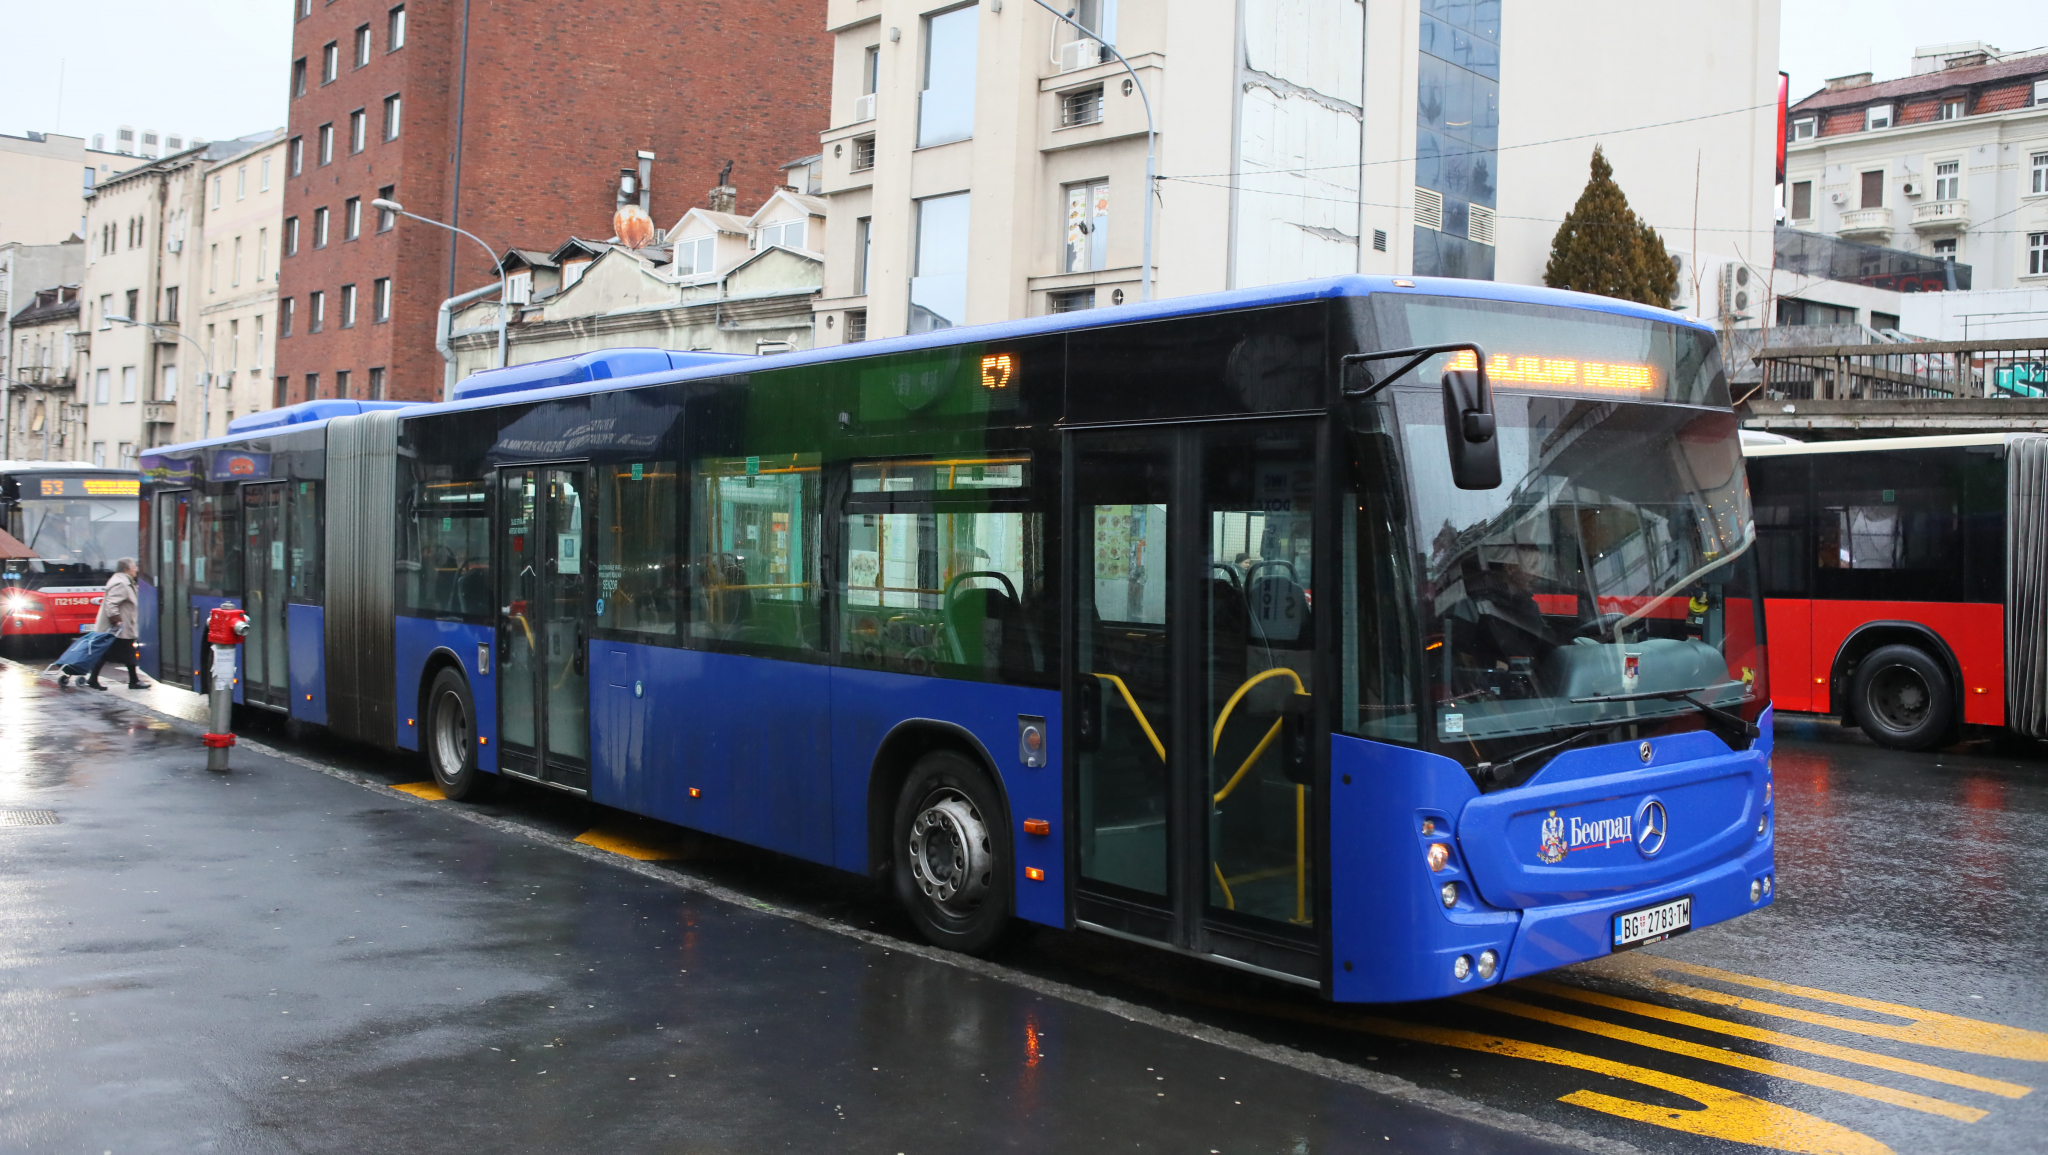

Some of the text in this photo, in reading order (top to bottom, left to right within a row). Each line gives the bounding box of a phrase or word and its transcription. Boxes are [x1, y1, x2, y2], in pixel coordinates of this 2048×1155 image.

[41, 480, 64, 495] 53
[55, 597, 90, 605] П21549
[1570, 815, 1632, 849] Београд
[1624, 916, 1639, 939] BG
